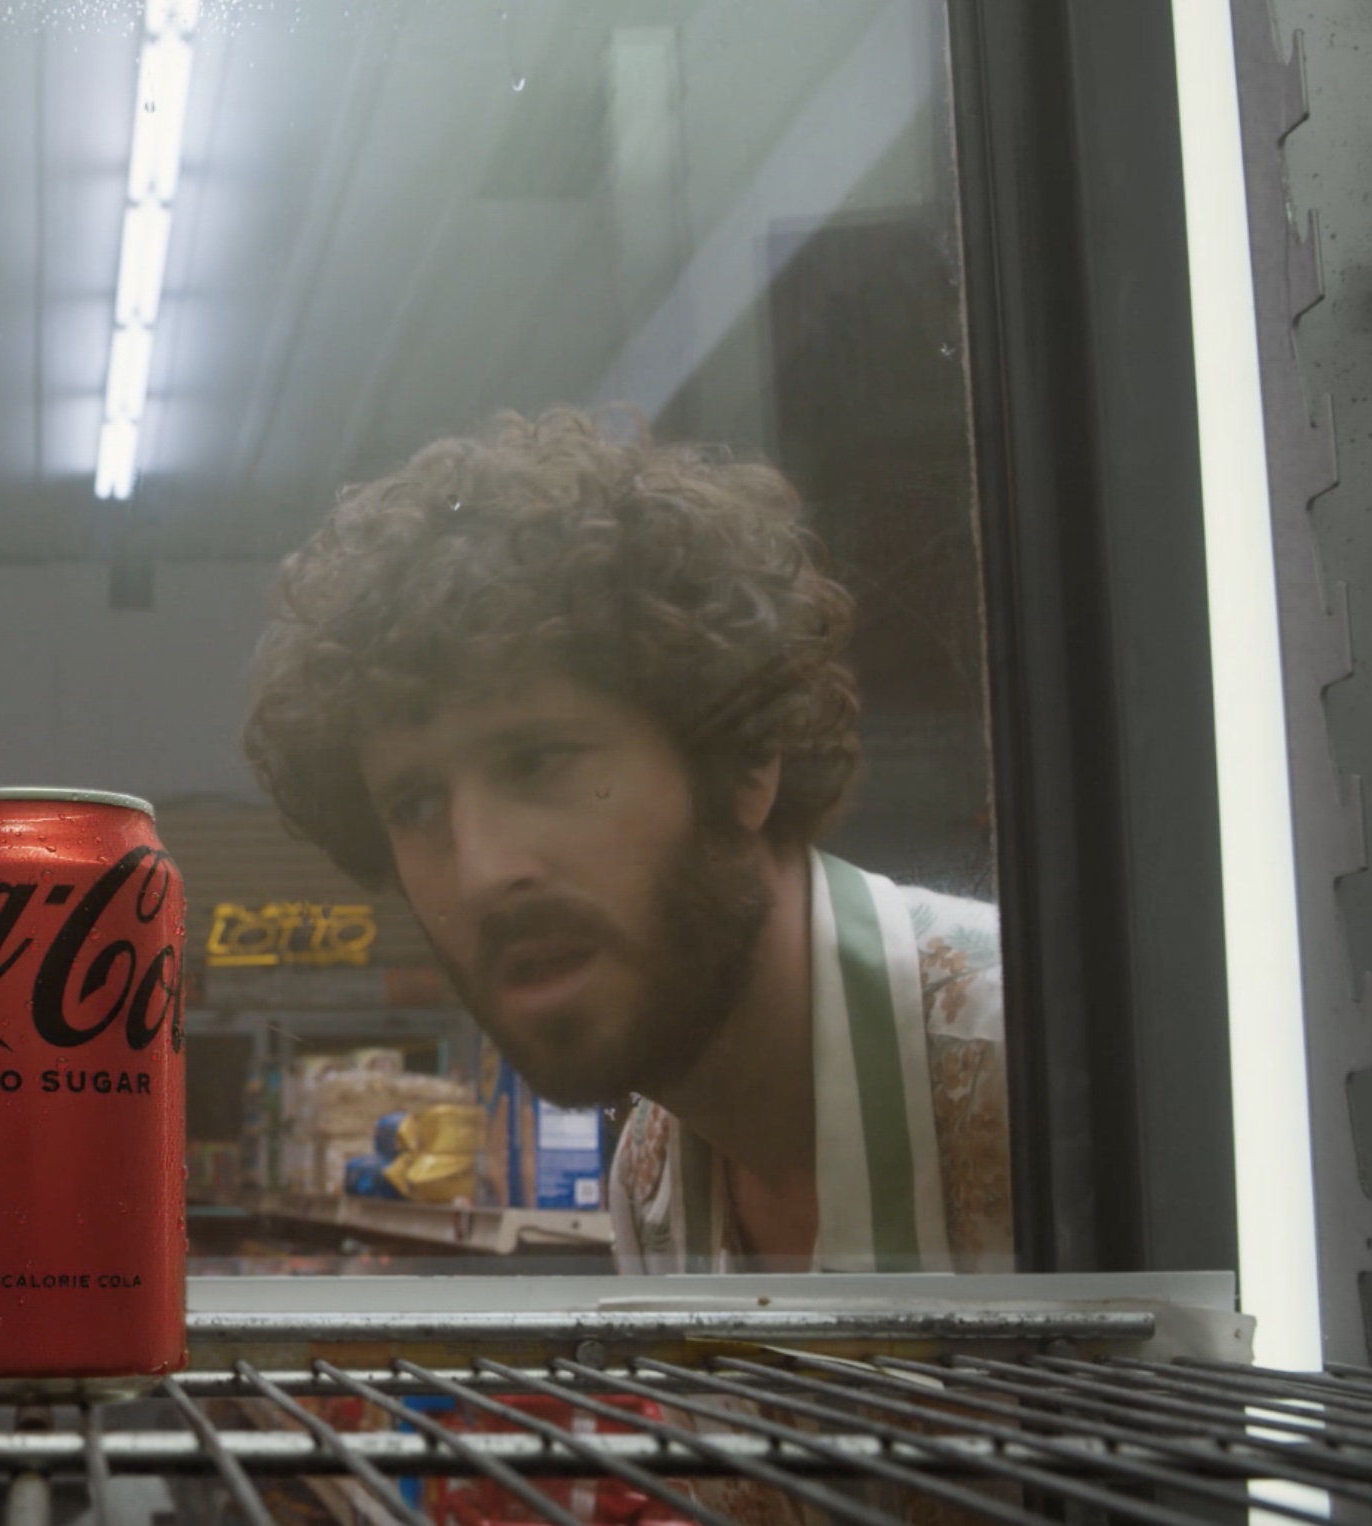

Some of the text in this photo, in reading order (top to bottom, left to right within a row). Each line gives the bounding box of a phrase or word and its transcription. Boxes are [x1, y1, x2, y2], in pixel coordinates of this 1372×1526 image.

[207, 904, 377, 959] LOTTO
[42, 1070, 151, 1095] SUGAR
[1, 1274, 90, 1289] CALORIE
[99, 1275, 141, 1288] COLA
